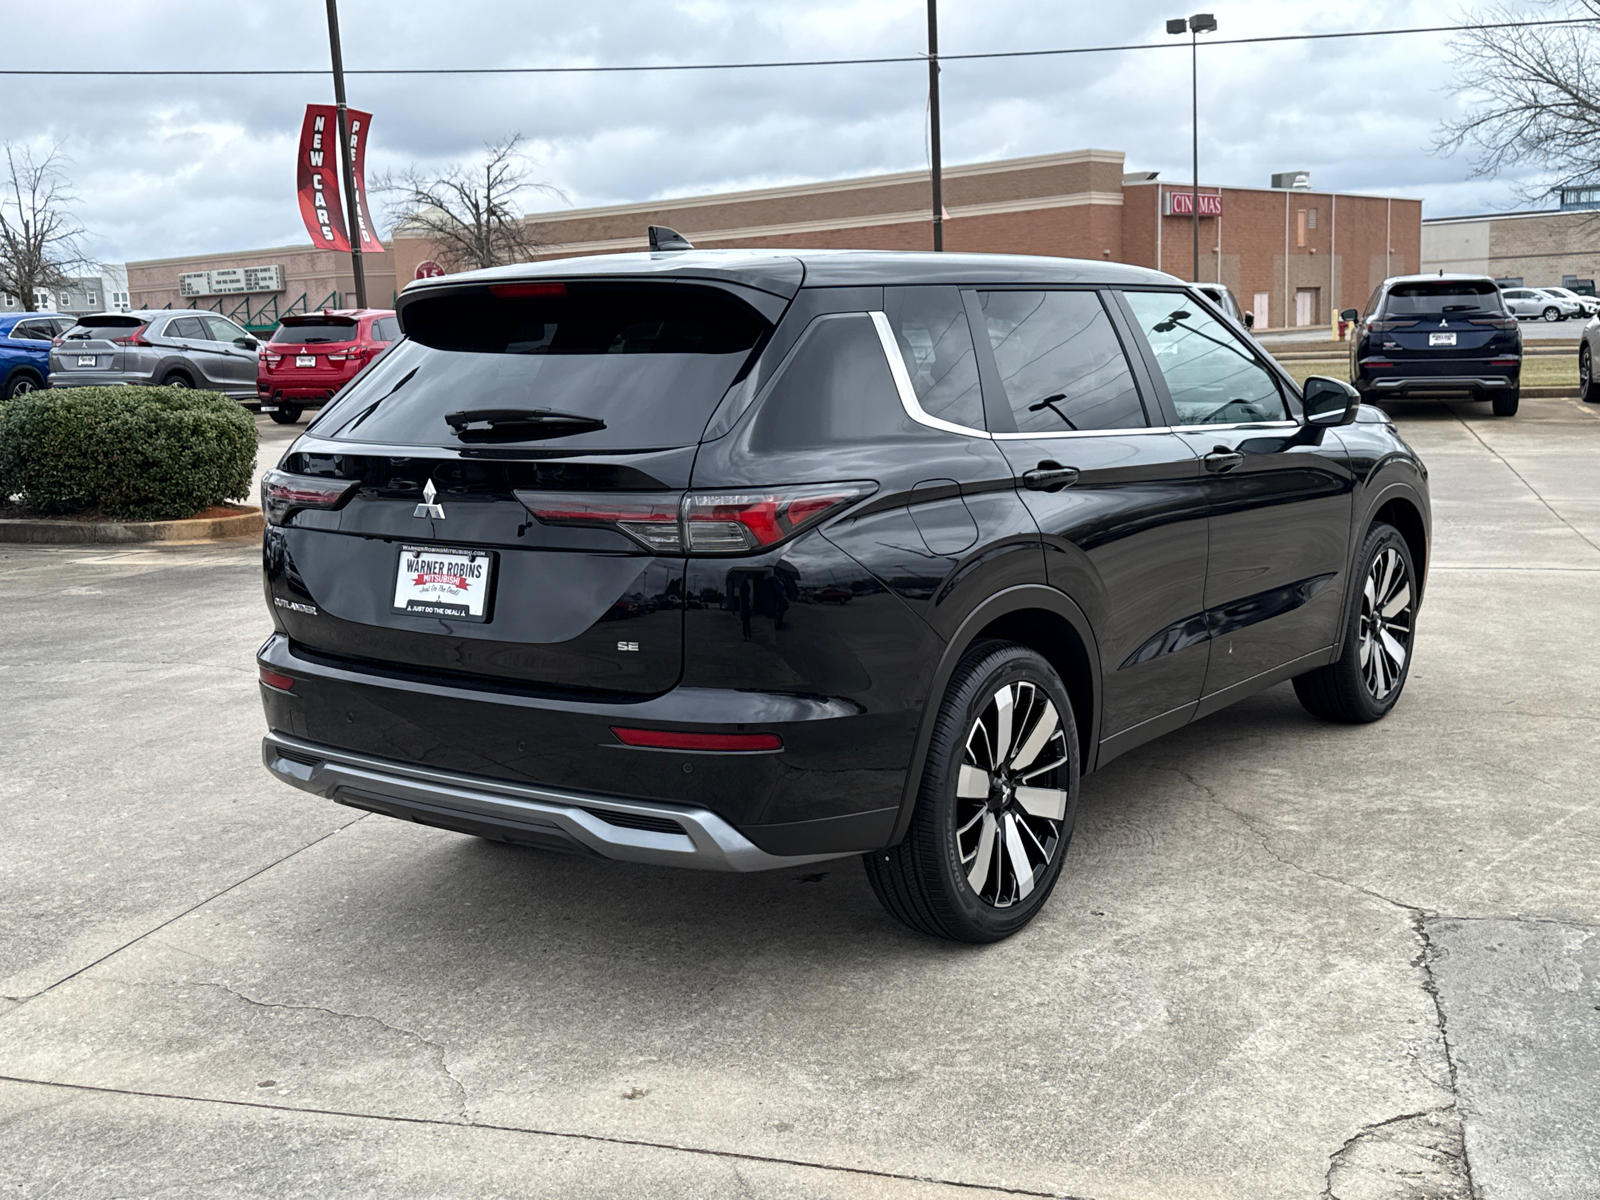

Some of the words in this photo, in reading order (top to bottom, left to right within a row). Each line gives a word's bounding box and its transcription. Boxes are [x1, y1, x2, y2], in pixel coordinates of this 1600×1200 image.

[309, 115, 326, 168] NEW
[312, 174, 335, 242] CARS
[1173, 195, 1222, 214] CINMAS
[406, 558, 445, 575] WARNER
[447, 561, 482, 579] ROBINS
[423, 574, 461, 586] MITSUBISHI
[274, 597, 318, 616] OUTLANDER
[412, 605, 425, 613] JUST
[617, 641, 639, 651] SE
[946, 817, 965, 893] ROADIAN
